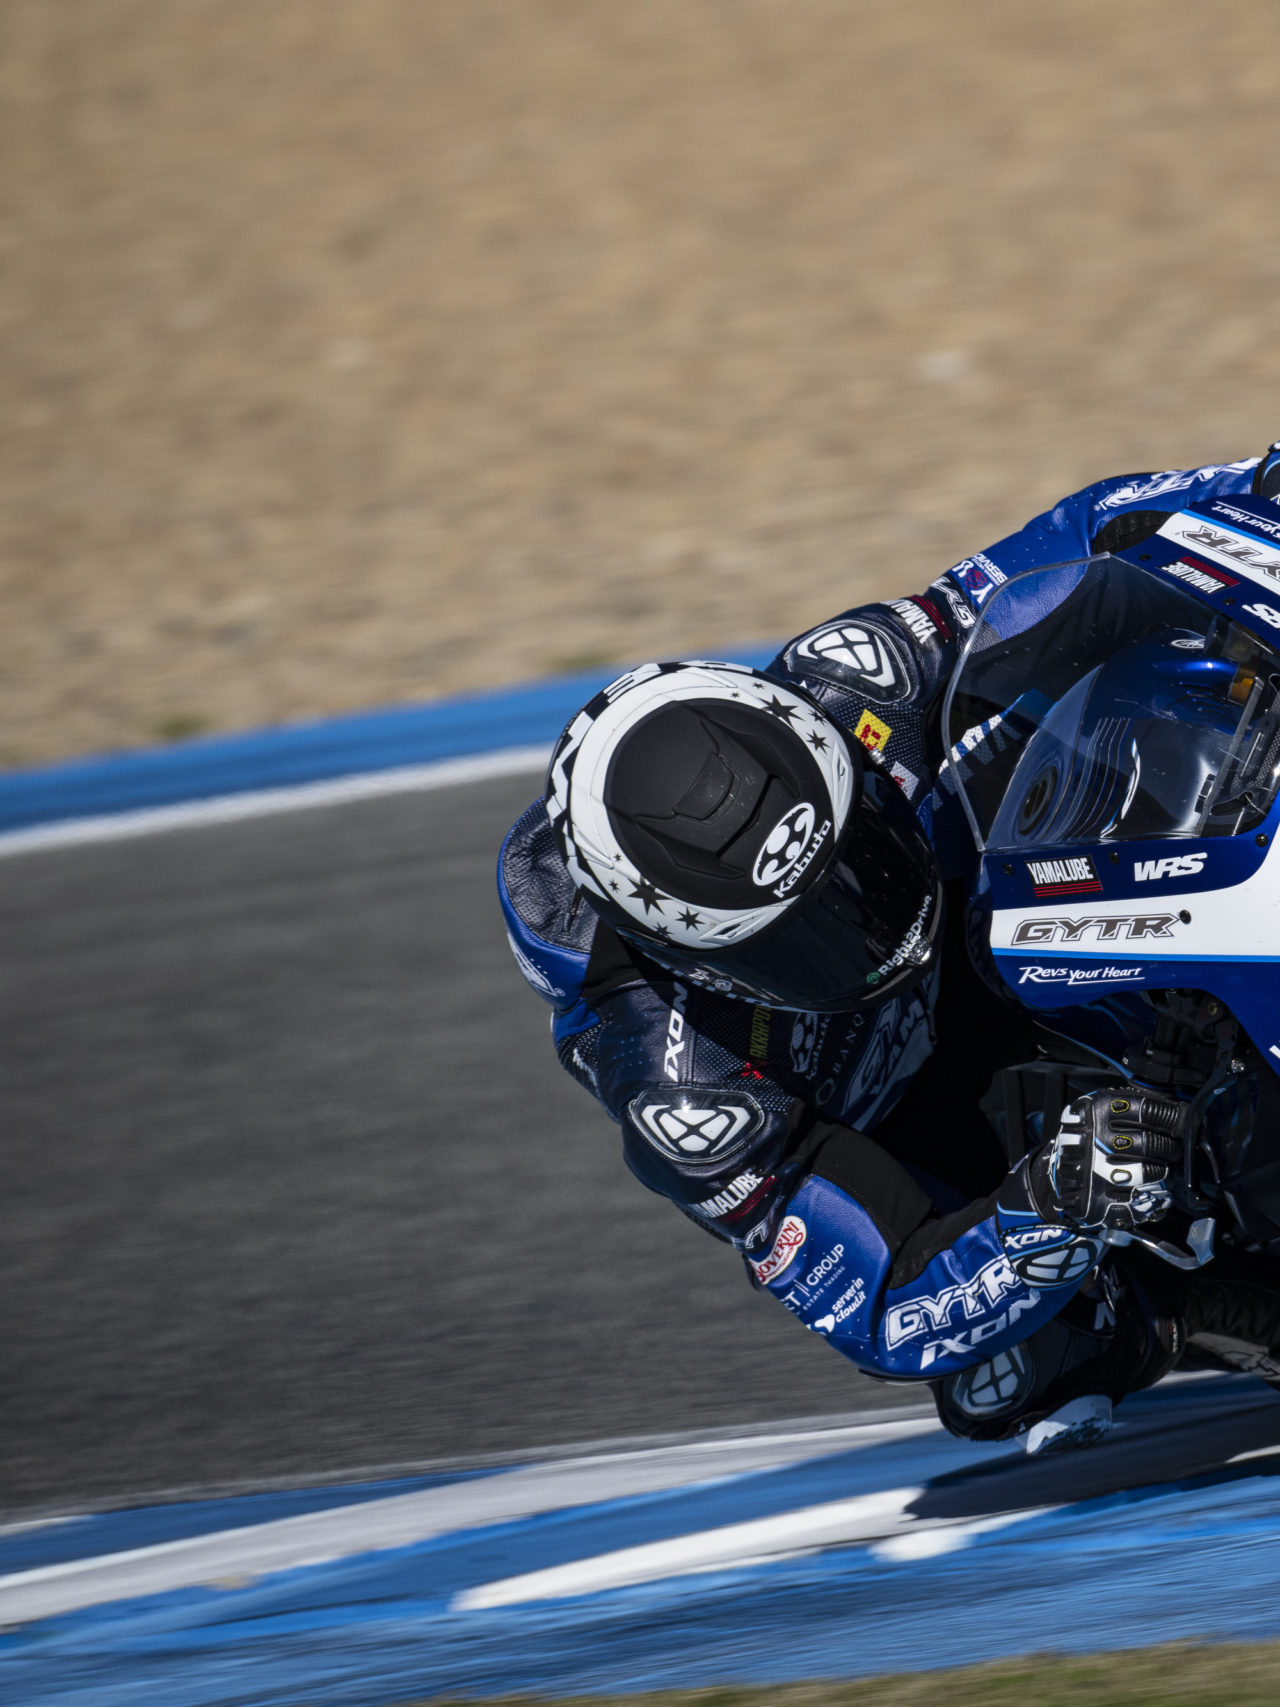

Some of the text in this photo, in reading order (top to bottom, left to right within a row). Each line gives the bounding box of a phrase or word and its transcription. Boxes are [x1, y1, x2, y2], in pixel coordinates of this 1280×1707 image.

[976, 552, 1008, 584] SERVIC
[1161, 561, 1228, 595] YAMALUBE
[890, 599, 938, 645] YAMAL
[773, 819, 832, 898] Kabuto
[1026, 857, 1095, 886] YAMALUBE
[1134, 852, 1208, 883] WRS
[878, 894, 933, 976] Right2Drive
[1010, 912, 1180, 946] GYTR
[1018, 966, 1068, 984] Revs
[1102, 966, 1144, 979] Heart
[750, 1005, 772, 1058] AKRAPO
[696, 1168, 765, 1218] MALUBE
[1004, 1228, 1062, 1249] XON
[806, 1243, 844, 1287] GROUP
[885, 1253, 1022, 1352] GYTR
